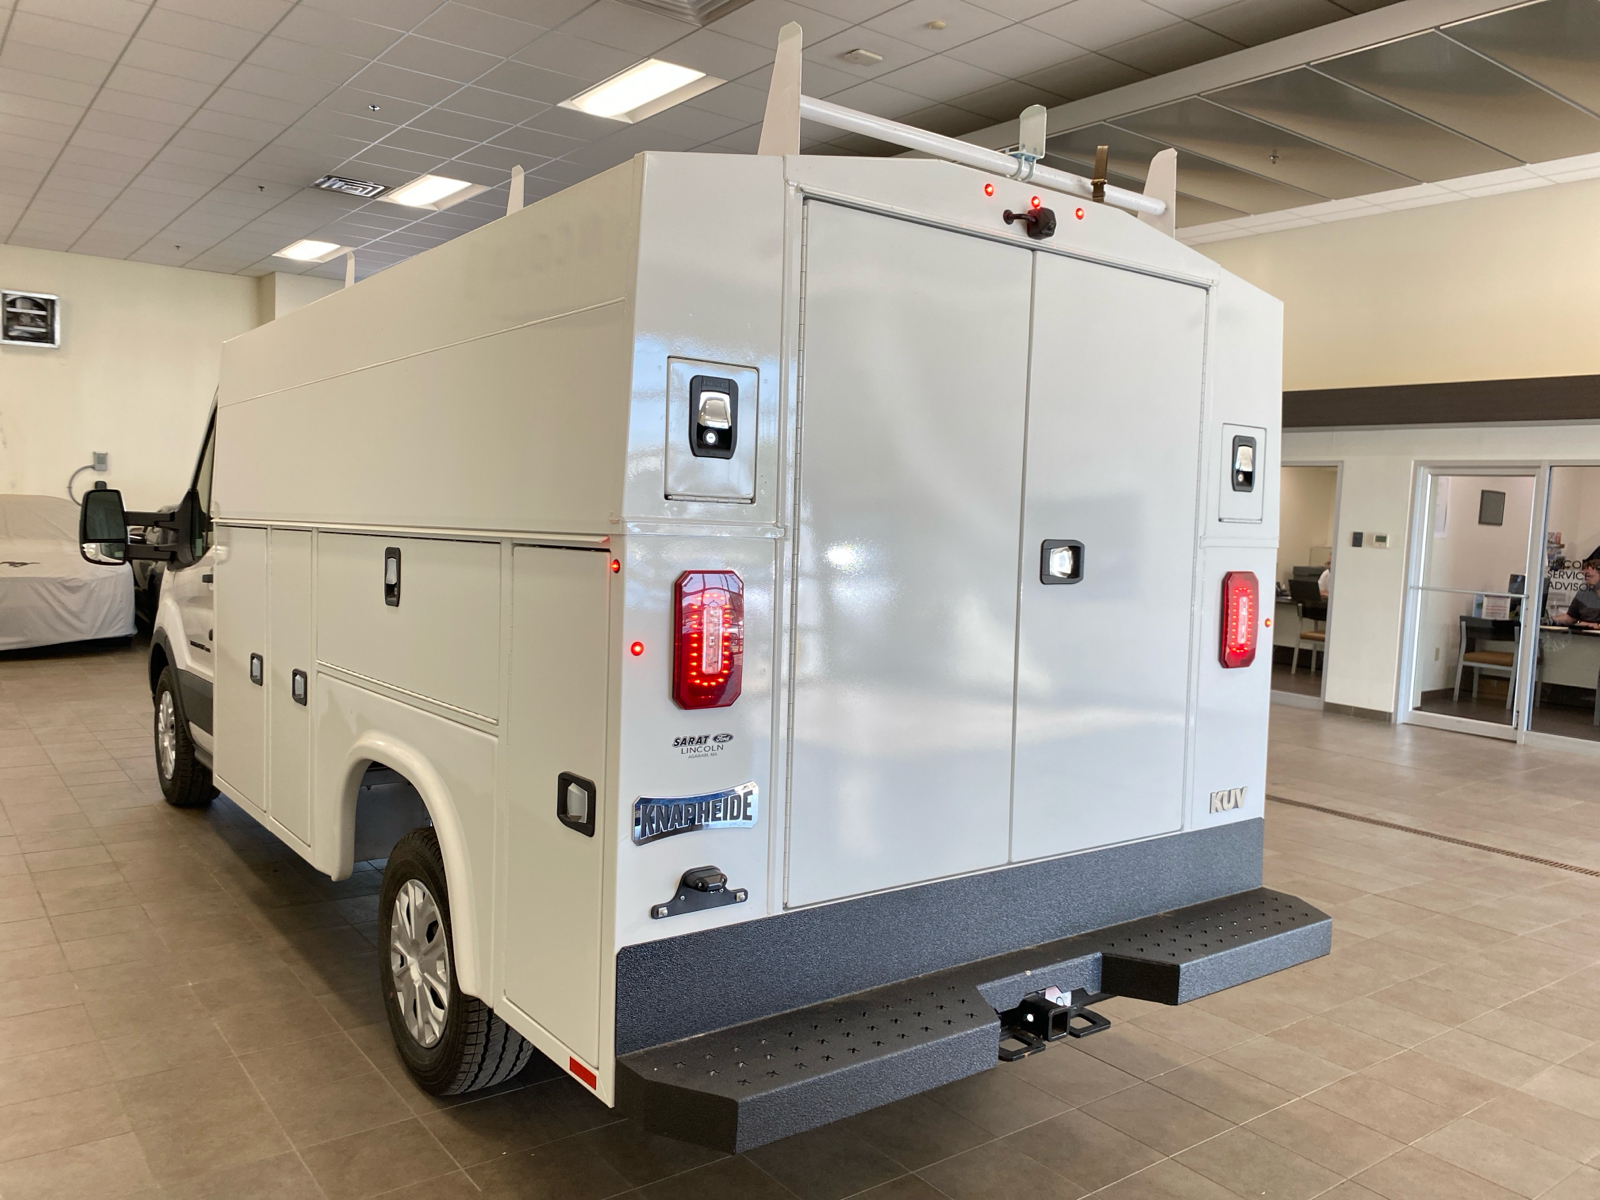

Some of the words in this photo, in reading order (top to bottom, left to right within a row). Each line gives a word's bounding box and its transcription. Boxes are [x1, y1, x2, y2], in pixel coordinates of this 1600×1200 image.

[1547, 559, 1596, 570] LINCON
[1547, 570, 1591, 581] SERVICE
[1547, 581, 1596, 592] ADVISOR
[672, 734, 711, 748] SARAT
[681, 744, 724, 754] LINCOLN
[1209, 786, 1248, 814] KUV
[639, 790, 753, 840] KNAPHEIDE
